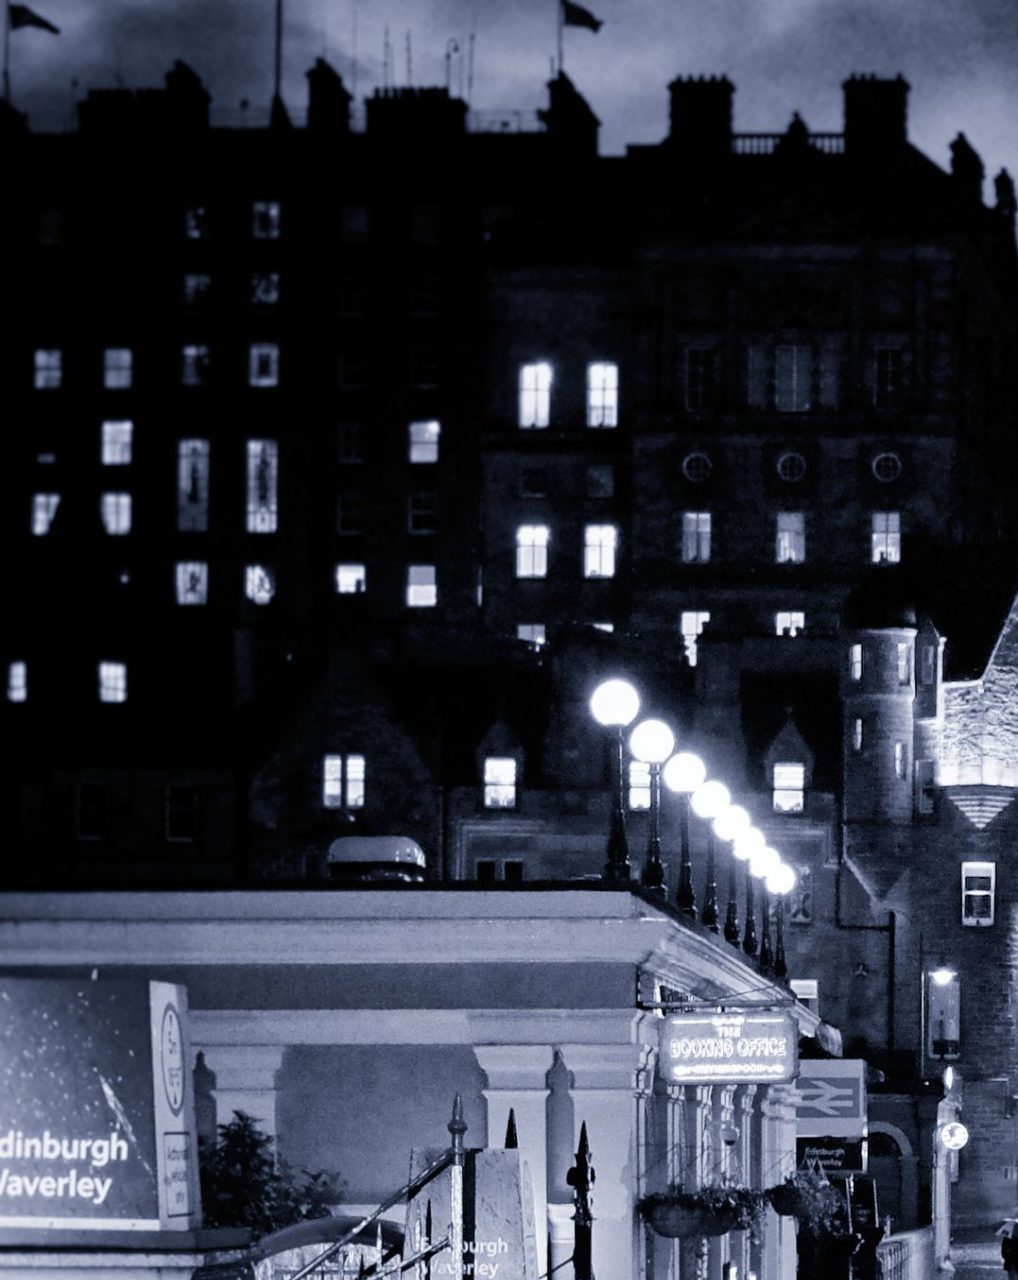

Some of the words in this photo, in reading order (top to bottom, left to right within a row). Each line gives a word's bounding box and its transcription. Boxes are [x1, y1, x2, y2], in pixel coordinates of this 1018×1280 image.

[670, 1038, 734, 1059] BOOKING
[737, 1037, 787, 1057] OFFICE
[0, 1129, 129, 1167] dinburgh
[0, 1168, 113, 1205] averley
[420, 1236, 509, 1257] Eurgh
